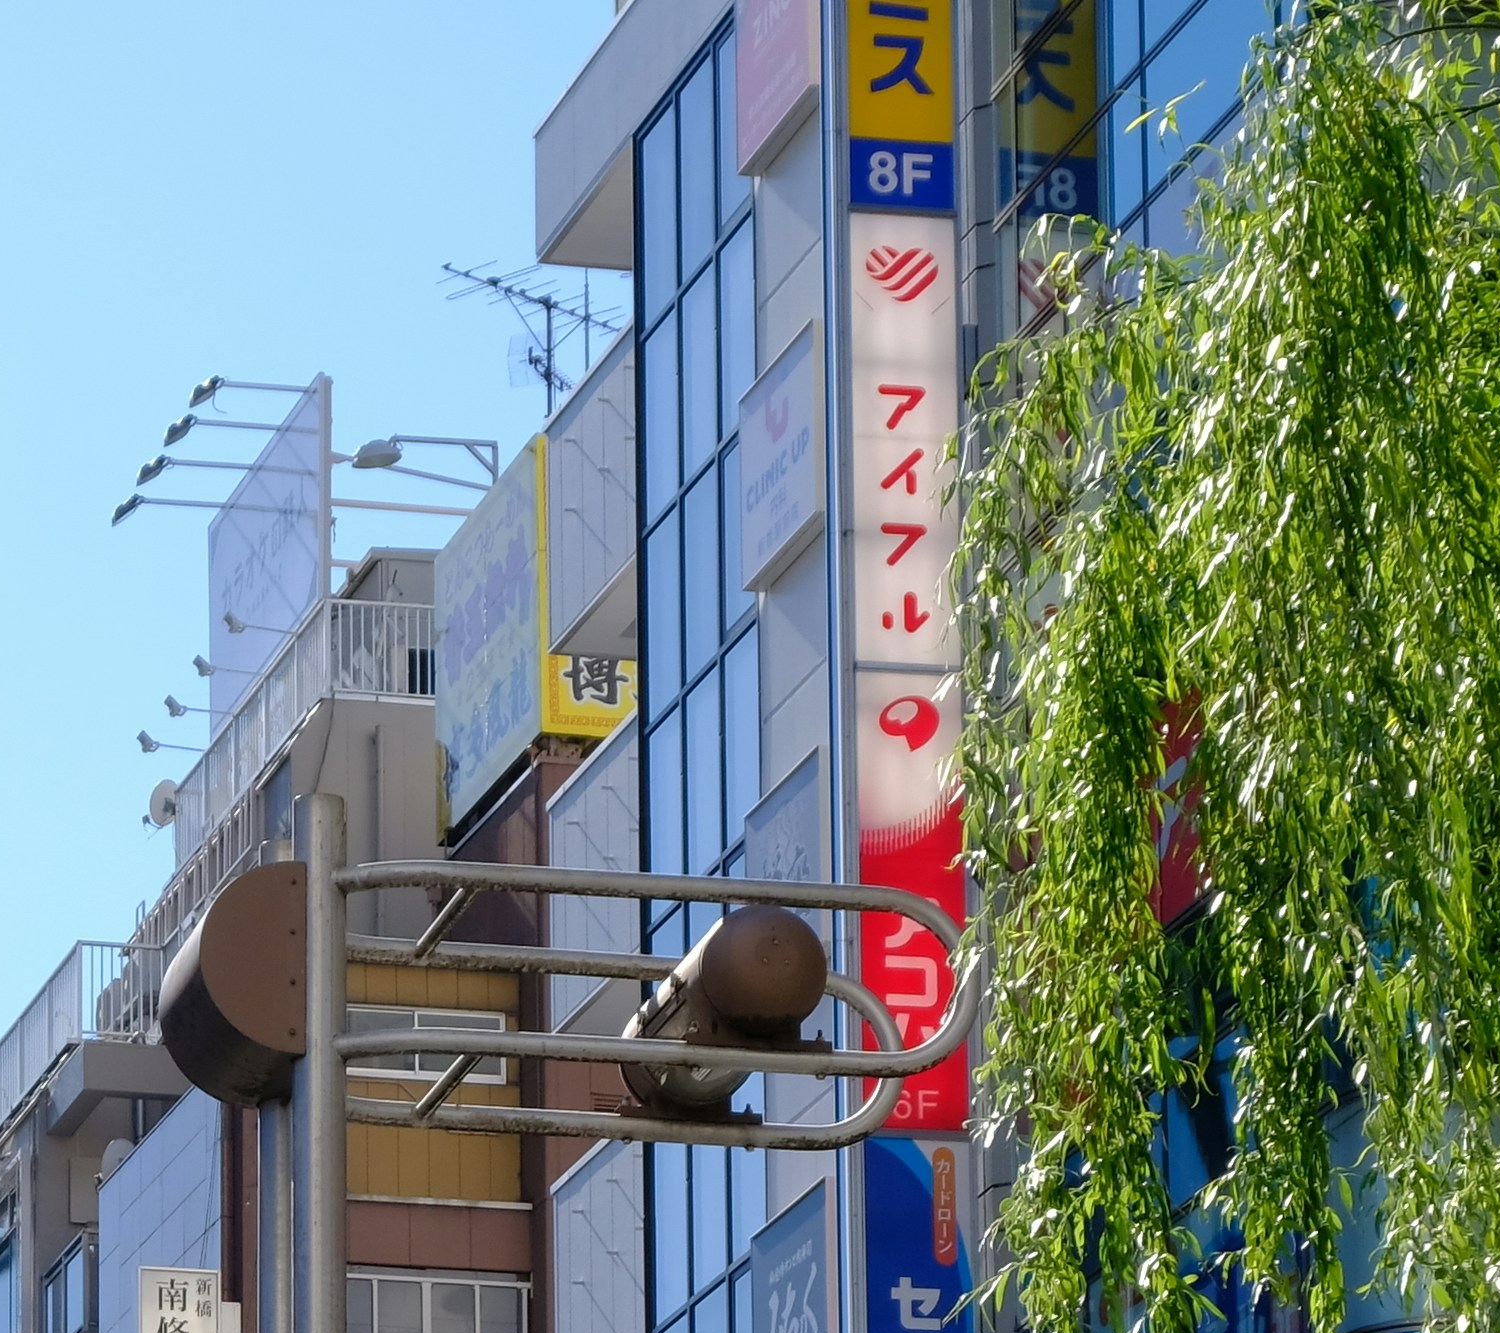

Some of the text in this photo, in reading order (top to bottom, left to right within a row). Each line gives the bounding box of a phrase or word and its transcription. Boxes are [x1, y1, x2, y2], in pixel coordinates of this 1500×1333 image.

[866, 150, 935, 195] 8F
[877, 383, 931, 635] アイフル
[935, 1156, 954, 1255] カードローン
[194, 1278, 213, 1319] 新橋
